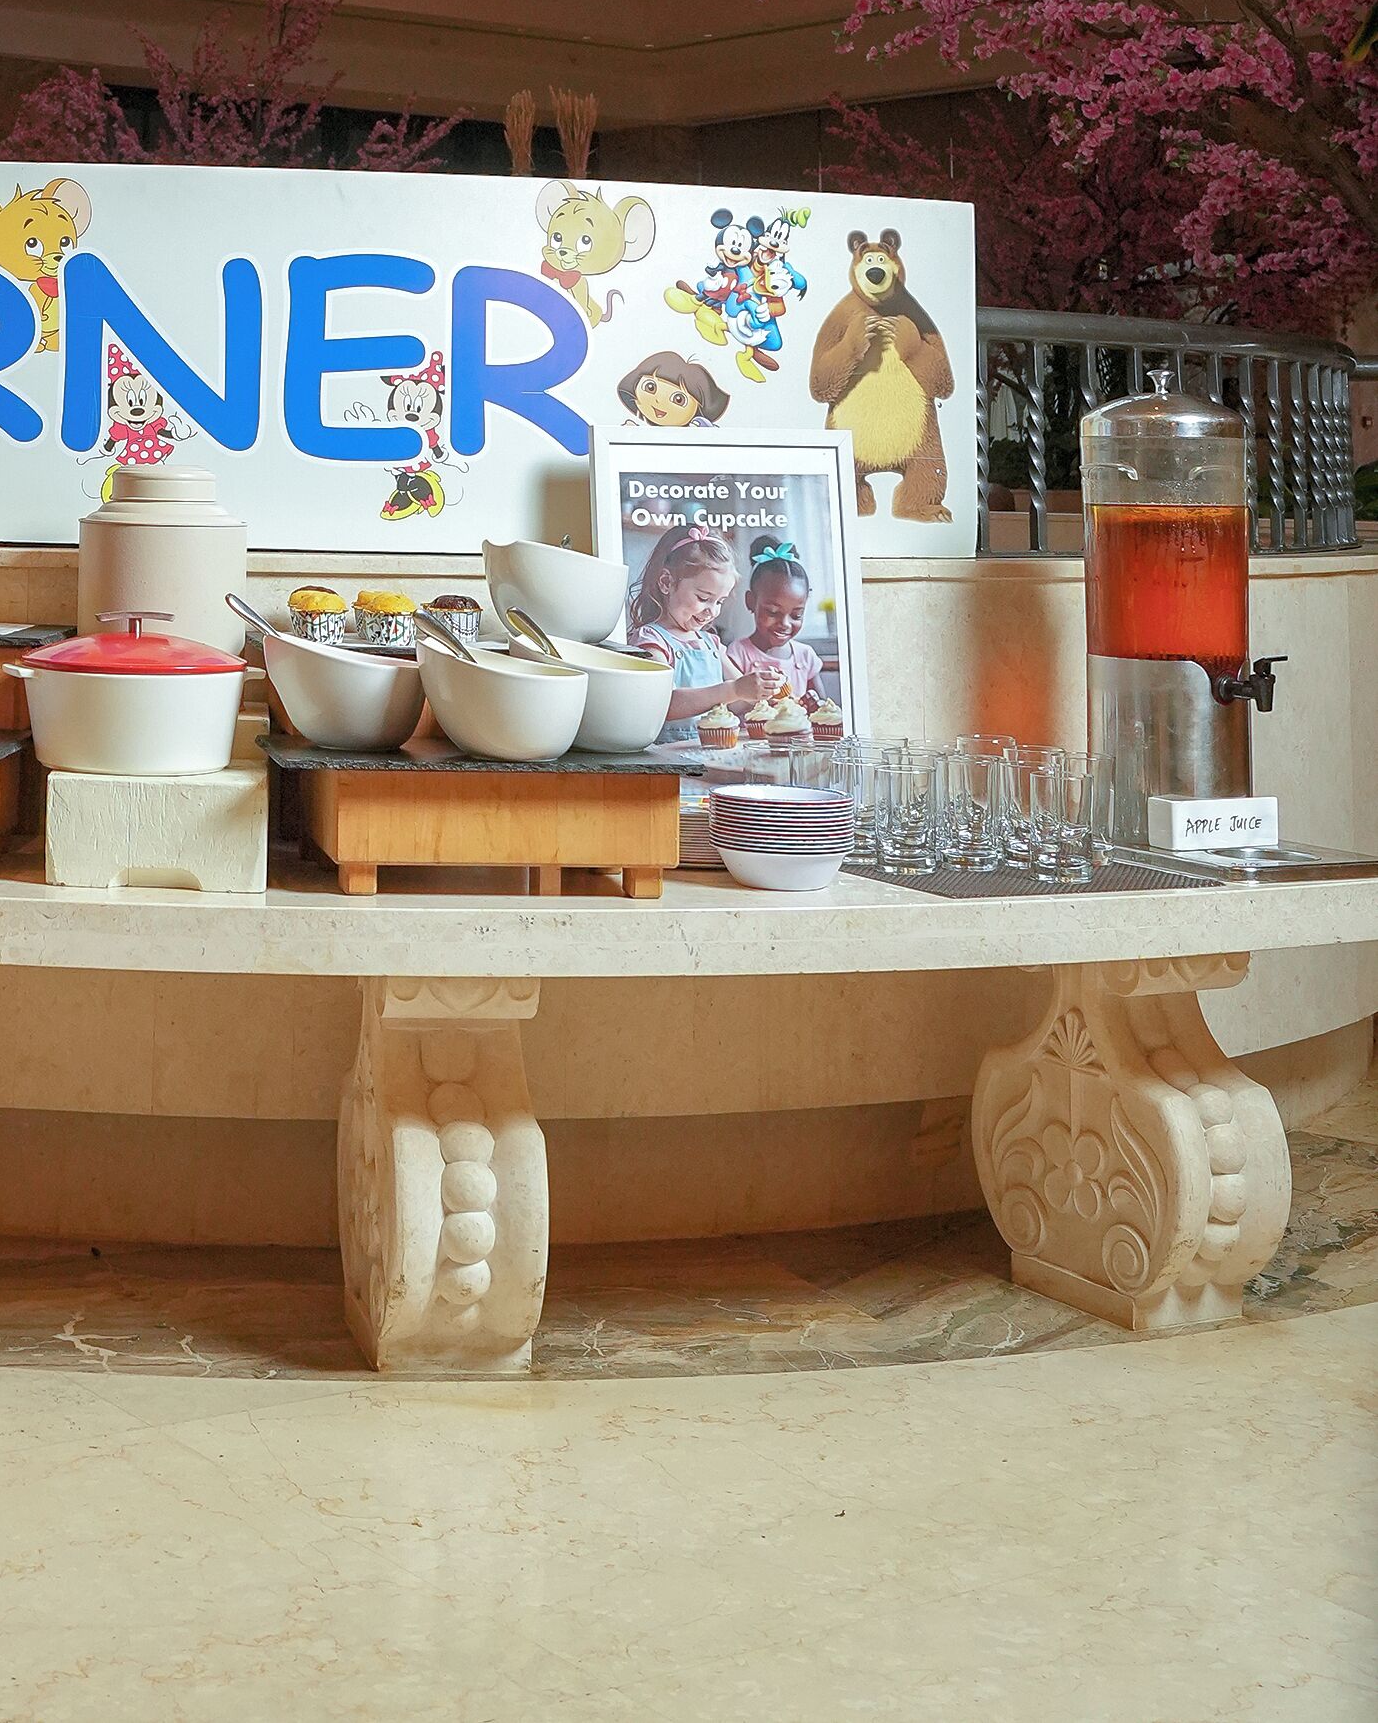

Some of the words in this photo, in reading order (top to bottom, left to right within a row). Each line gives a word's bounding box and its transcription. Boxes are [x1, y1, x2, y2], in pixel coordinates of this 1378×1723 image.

[628, 480, 729, 500] Decorate
[735, 481, 789, 500] Your
[631, 508, 686, 527] Own
[693, 508, 788, 532] Cupcake
[1184, 817, 1222, 837] APPLE
[1229, 814, 1262, 832] JUICE
